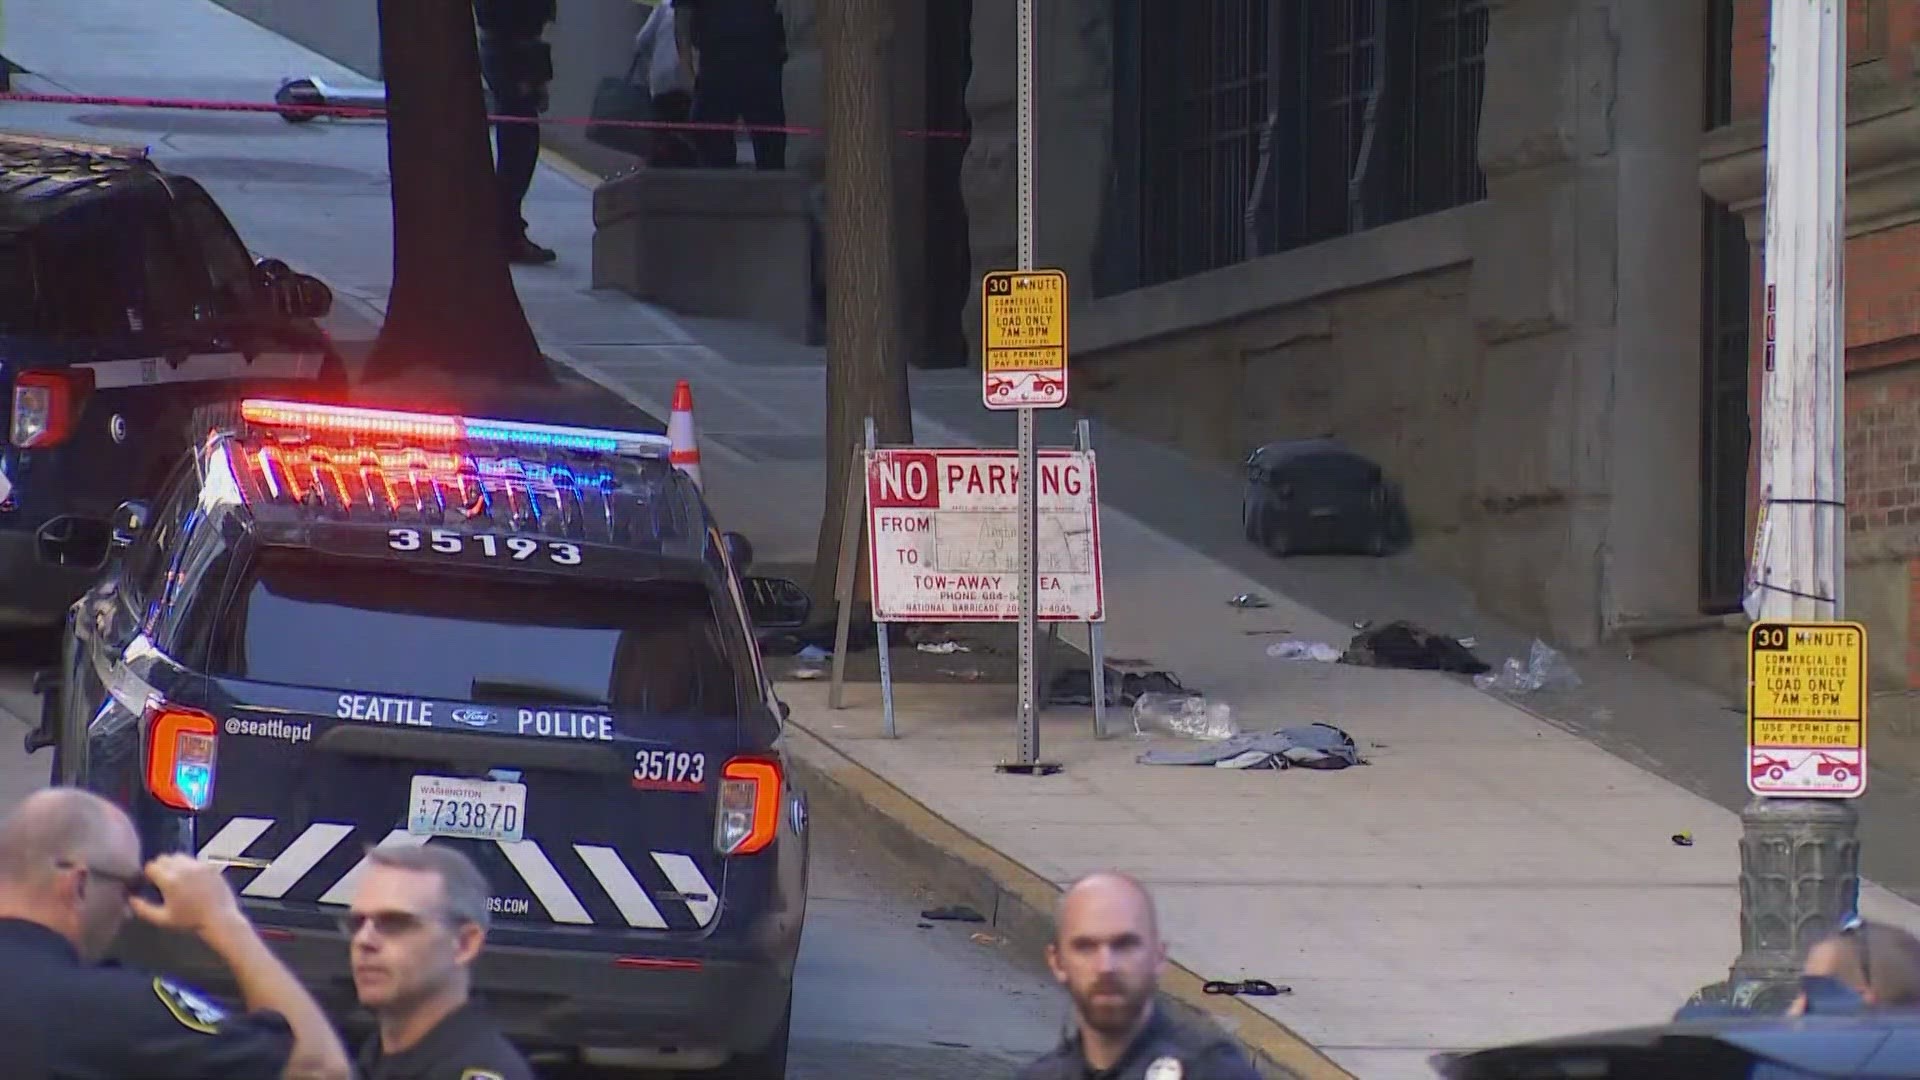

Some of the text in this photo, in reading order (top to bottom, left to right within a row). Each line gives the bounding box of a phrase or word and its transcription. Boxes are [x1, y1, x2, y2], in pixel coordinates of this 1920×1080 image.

[990, 279, 1008, 293] 30
[997, 316, 1052, 327] LOAD ONLY
[879, 461, 1081, 500] NO PARKNG
[881, 517, 930, 532] FROM
[388, 528, 581, 565] 35193
[897, 549, 918, 564] TO
[914, 575, 1001, 590] TOW-AWAY
[940, 592, 977, 600] PHONE
[905, 604, 945, 612] NATIONAL
[952, 604, 999, 612] BARRICADE
[1759, 629, 1855, 647] 30 MINUTE
[1765, 655, 1828, 665] COMMERCIAL
[1765, 667, 1847, 677] PERMIT VEHICLE
[1767, 679, 1845, 692] LOAD ONLY
[336, 695, 433, 726] SEATTLE
[518, 709, 613, 740] POLICE
[224, 717, 311, 744] @seattlepd
[1761, 723, 1783, 732] USE
[1790, 723, 1829, 732] PERMIT
[1763, 734, 1847, 744] PAY BY PHONE
[633, 750, 705, 783] 35193
[420, 785, 482, 799] WASHINGTON
[432, 799, 517, 832] 73387D
